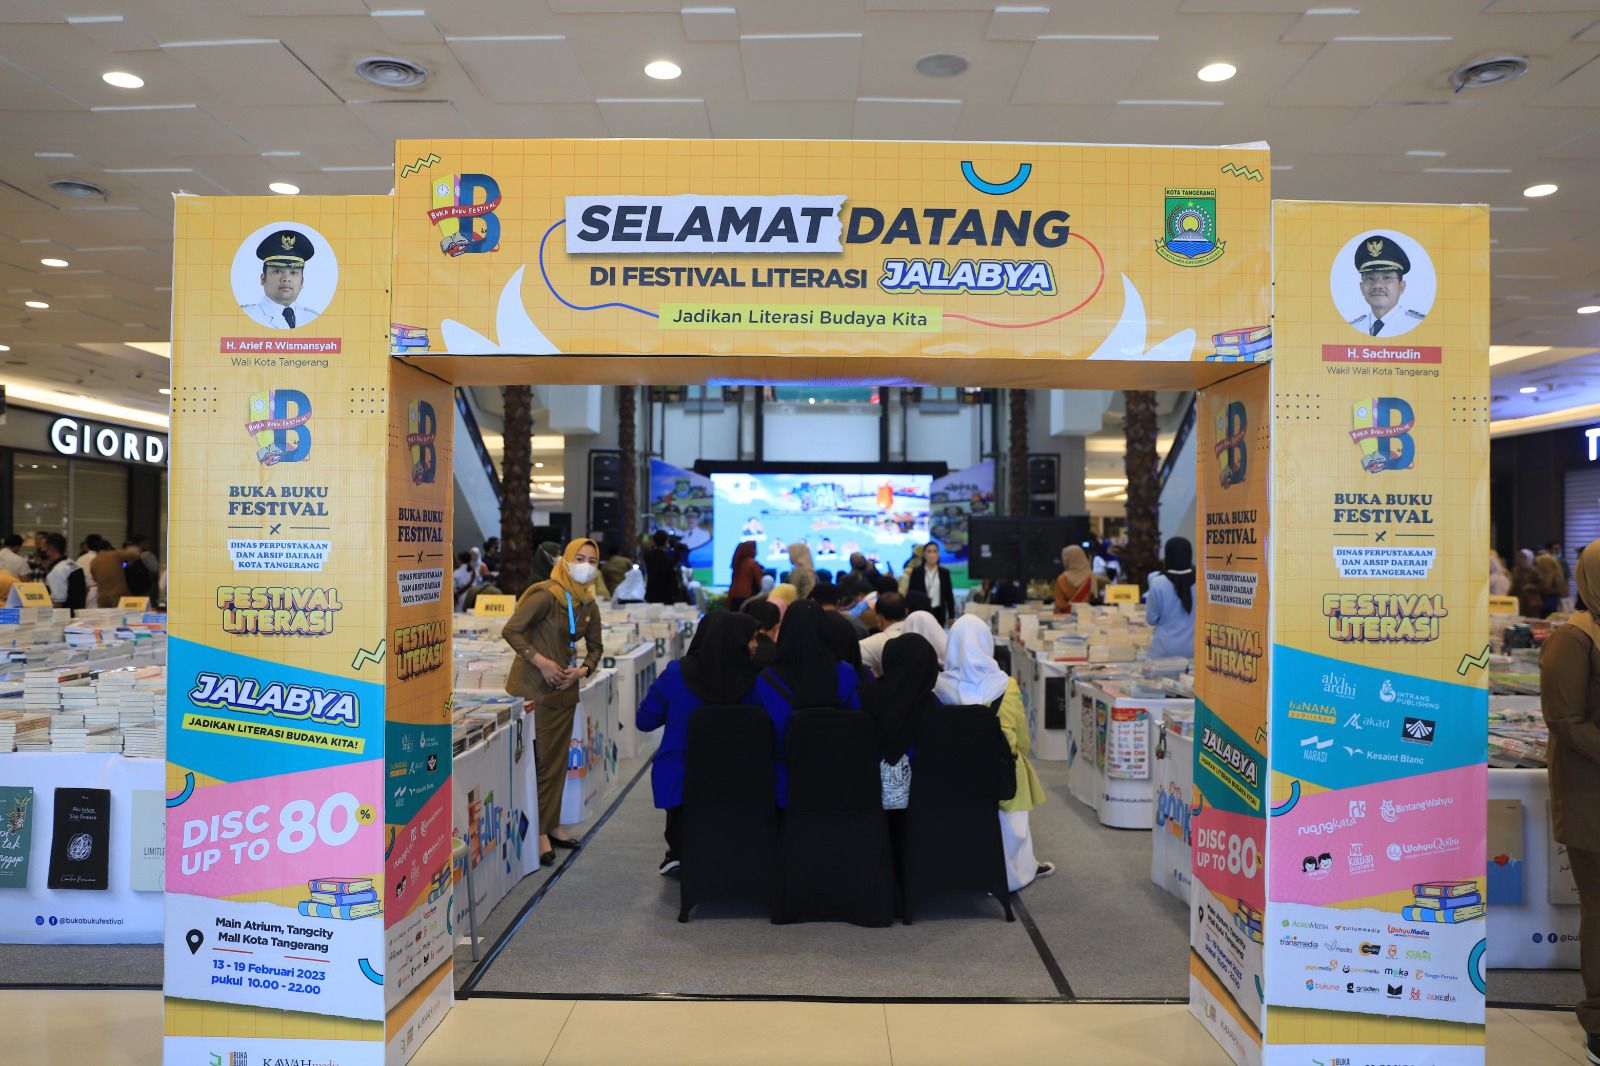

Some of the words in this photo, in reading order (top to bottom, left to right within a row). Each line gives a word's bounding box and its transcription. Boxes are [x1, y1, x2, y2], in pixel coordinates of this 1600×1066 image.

[577, 205, 833, 243] SELAMAT
[846, 207, 1071, 248] DATANG
[590, 266, 616, 286] DI
[622, 266, 746, 288] FESTIVAL
[752, 267, 867, 289] LITERASI
[880, 259, 1054, 293] JALABYA
[673, 308, 742, 325] Jadikan
[749, 309, 816, 325] Literasi
[821, 310, 886, 328] Budaya
[893, 312, 927, 326] Kita
[226, 341, 236, 350] H.
[240, 341, 264, 350] Arief
[266, 341, 272, 350] R
[275, 341, 337, 352] Wismansyah
[1347, 348, 1359, 358] H.
[1362, 348, 1421, 360] Sachrudin
[231, 357, 251, 366] Wali
[254, 358, 276, 366] Kota
[279, 358, 329, 368] Tangerang
[1327, 365, 1350, 375] Wakil
[1352, 366, 1370, 375] Wali
[1372, 366, 1393, 376] Kota
[1395, 367, 1440, 377] Tangerang
[52, 418, 168, 463] GIORD
[229, 486, 276, 498] BUKA
[281, 487, 328, 498] BUKU
[1334, 493, 1381, 505] BUKA
[1386, 494, 1433, 506] BUKU
[228, 501, 328, 516] FESTIVAL
[399, 508, 421, 522] BUKA
[423, 509, 443, 523] BUKU
[1333, 509, 1433, 524] FESTIVAL
[1206, 512, 1230, 525] BUKA
[1232, 510, 1257, 524] BUKU
[398, 525, 443, 542] FESTIVAL
[1206, 528, 1257, 544] FESTIVAL
[259, 542, 328, 550] PERPUSTAKAAN
[1336, 549, 1363, 557] DINAS
[285, 552, 322, 560] DAERAH
[1391, 559, 1428, 567] DAERAH
[238, 561, 262, 569] KOTA
[264, 561, 320, 569] TANGERANG
[1344, 568, 1368, 576] KOTA
[217, 586, 342, 611] FESTIVAL
[1323, 593, 1448, 617] FESTIVAL
[223, 609, 333, 635] LITERASI
[1329, 616, 1440, 642] LITERASI
[394, 619, 447, 655] FESTIVAL
[1205, 622, 1262, 657] FESTIVAL
[397, 643, 443, 680] LITERASI
[1206, 646, 1257, 682] LITERASI
[1323, 682, 1357, 697] ardhi
[1397, 691, 1430, 702] INTRANS
[189, 673, 358, 724] JALABYA
[1396, 698, 1440, 710] PUBLISHING
[1363, 716, 1389, 728] akad
[188, 717, 235, 732] JADIKAN
[237, 723, 284, 739] LITERASI
[286, 730, 328, 745] BUDAYA
[330, 736, 358, 749] KITA!
[1202, 727, 1257, 786] JALABYA
[1303, 749, 1328, 762] NARASI
[1367, 751, 1398, 762] Kesaint
[1400, 754, 1424, 764] Blanc
[182, 804, 271, 848] DISC
[1198, 828, 1226, 850] DISC
[181, 848, 221, 876] UP
[229, 838, 270, 864] TO
[1197, 851, 1210, 868] UP
[1212, 854, 1226, 871] TO
[59, 917, 124, 926] @bukabukufestival
[215, 917, 241, 929] Main
[243, 919, 284, 934] Atrium,
[287, 924, 334, 940] Tangcity
[218, 931, 240, 943] Mall
[242, 934, 269, 946] Kota
[270, 937, 329, 954] Tangerang
[212, 959, 225, 969] 13
[233, 961, 246, 971] 19
[248, 963, 294, 978] Februari
[296, 969, 326, 981] 2023
[211, 974, 242, 987] pukul
[248, 978, 279, 990] 10.00
[288, 982, 321, 995] 22.00
